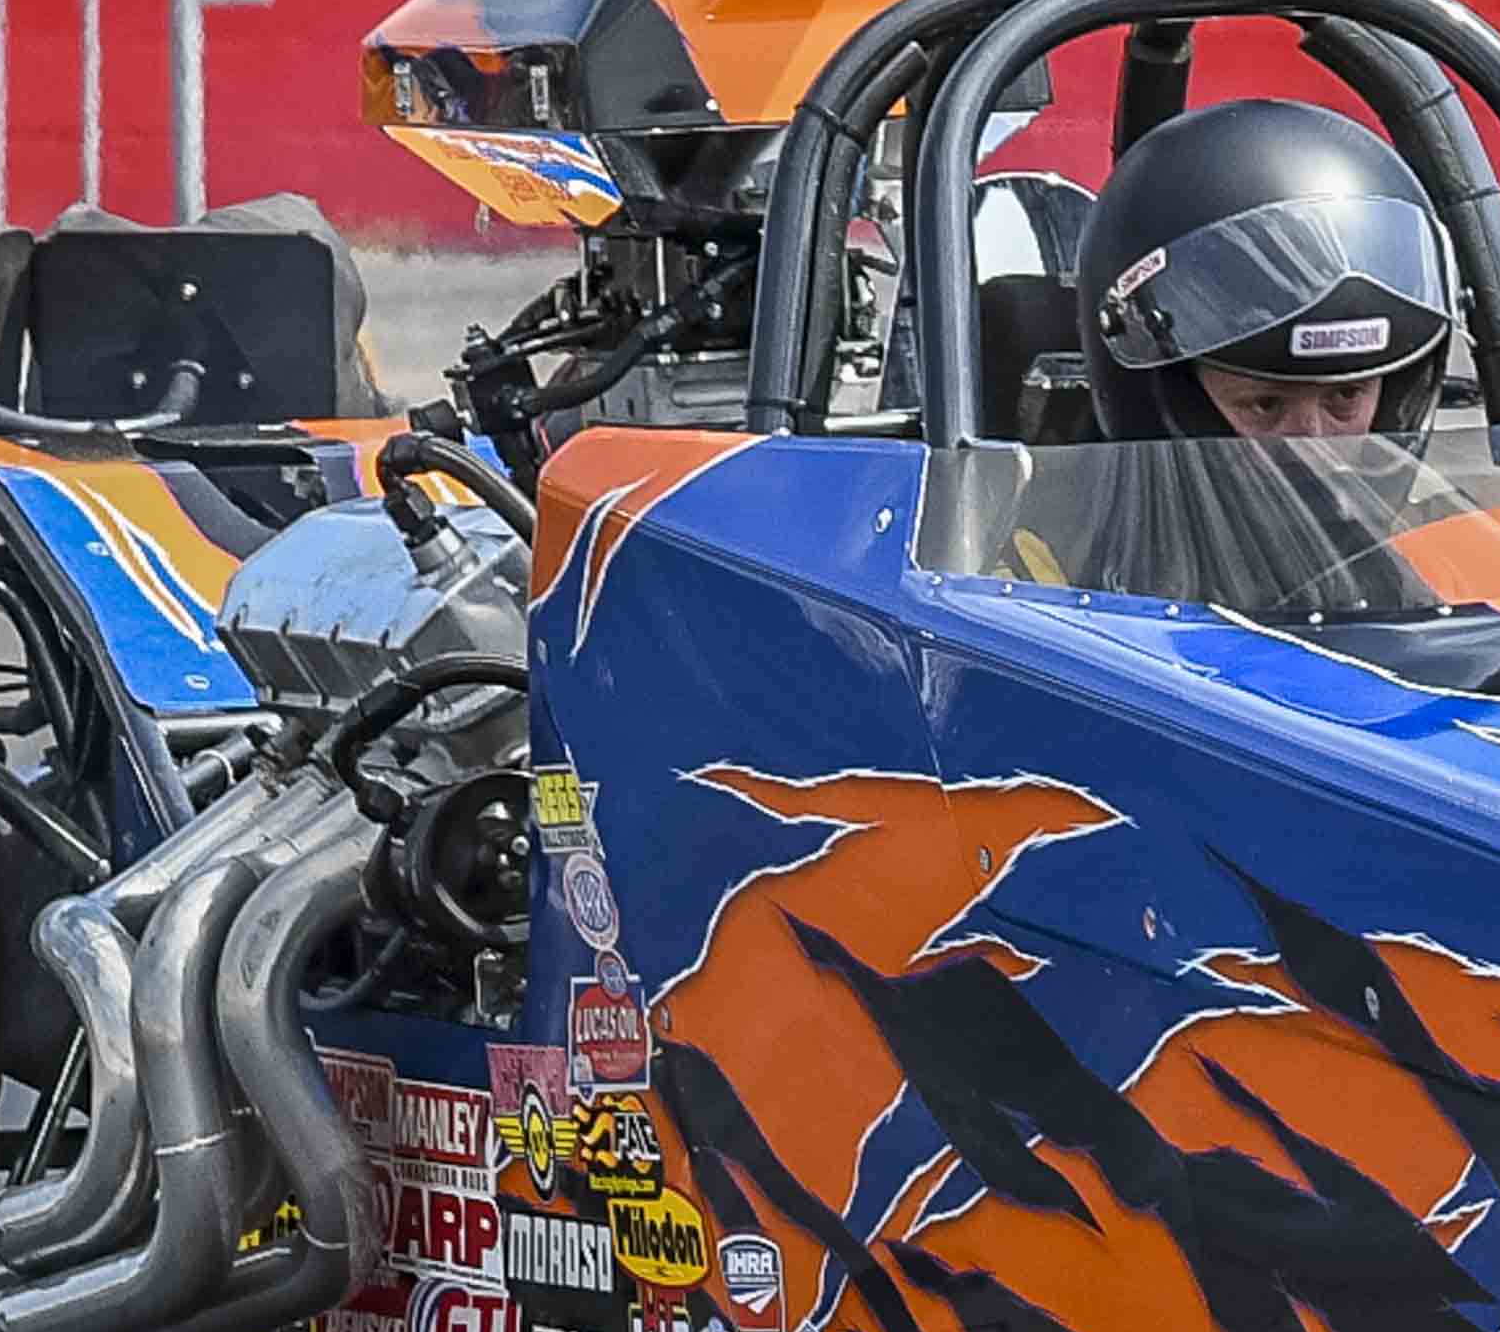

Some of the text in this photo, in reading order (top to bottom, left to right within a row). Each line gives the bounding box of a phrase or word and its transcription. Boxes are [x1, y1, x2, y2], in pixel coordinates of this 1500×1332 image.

[1299, 323, 1383, 351] SIMPSON
[396, 1093, 482, 1157] MANLEY
[393, 1186, 500, 1269] ARP
[508, 1213, 613, 1292] MOROSO
[613, 1204, 705, 1267] Milodon
[727, 1250, 774, 1275] IHRA
